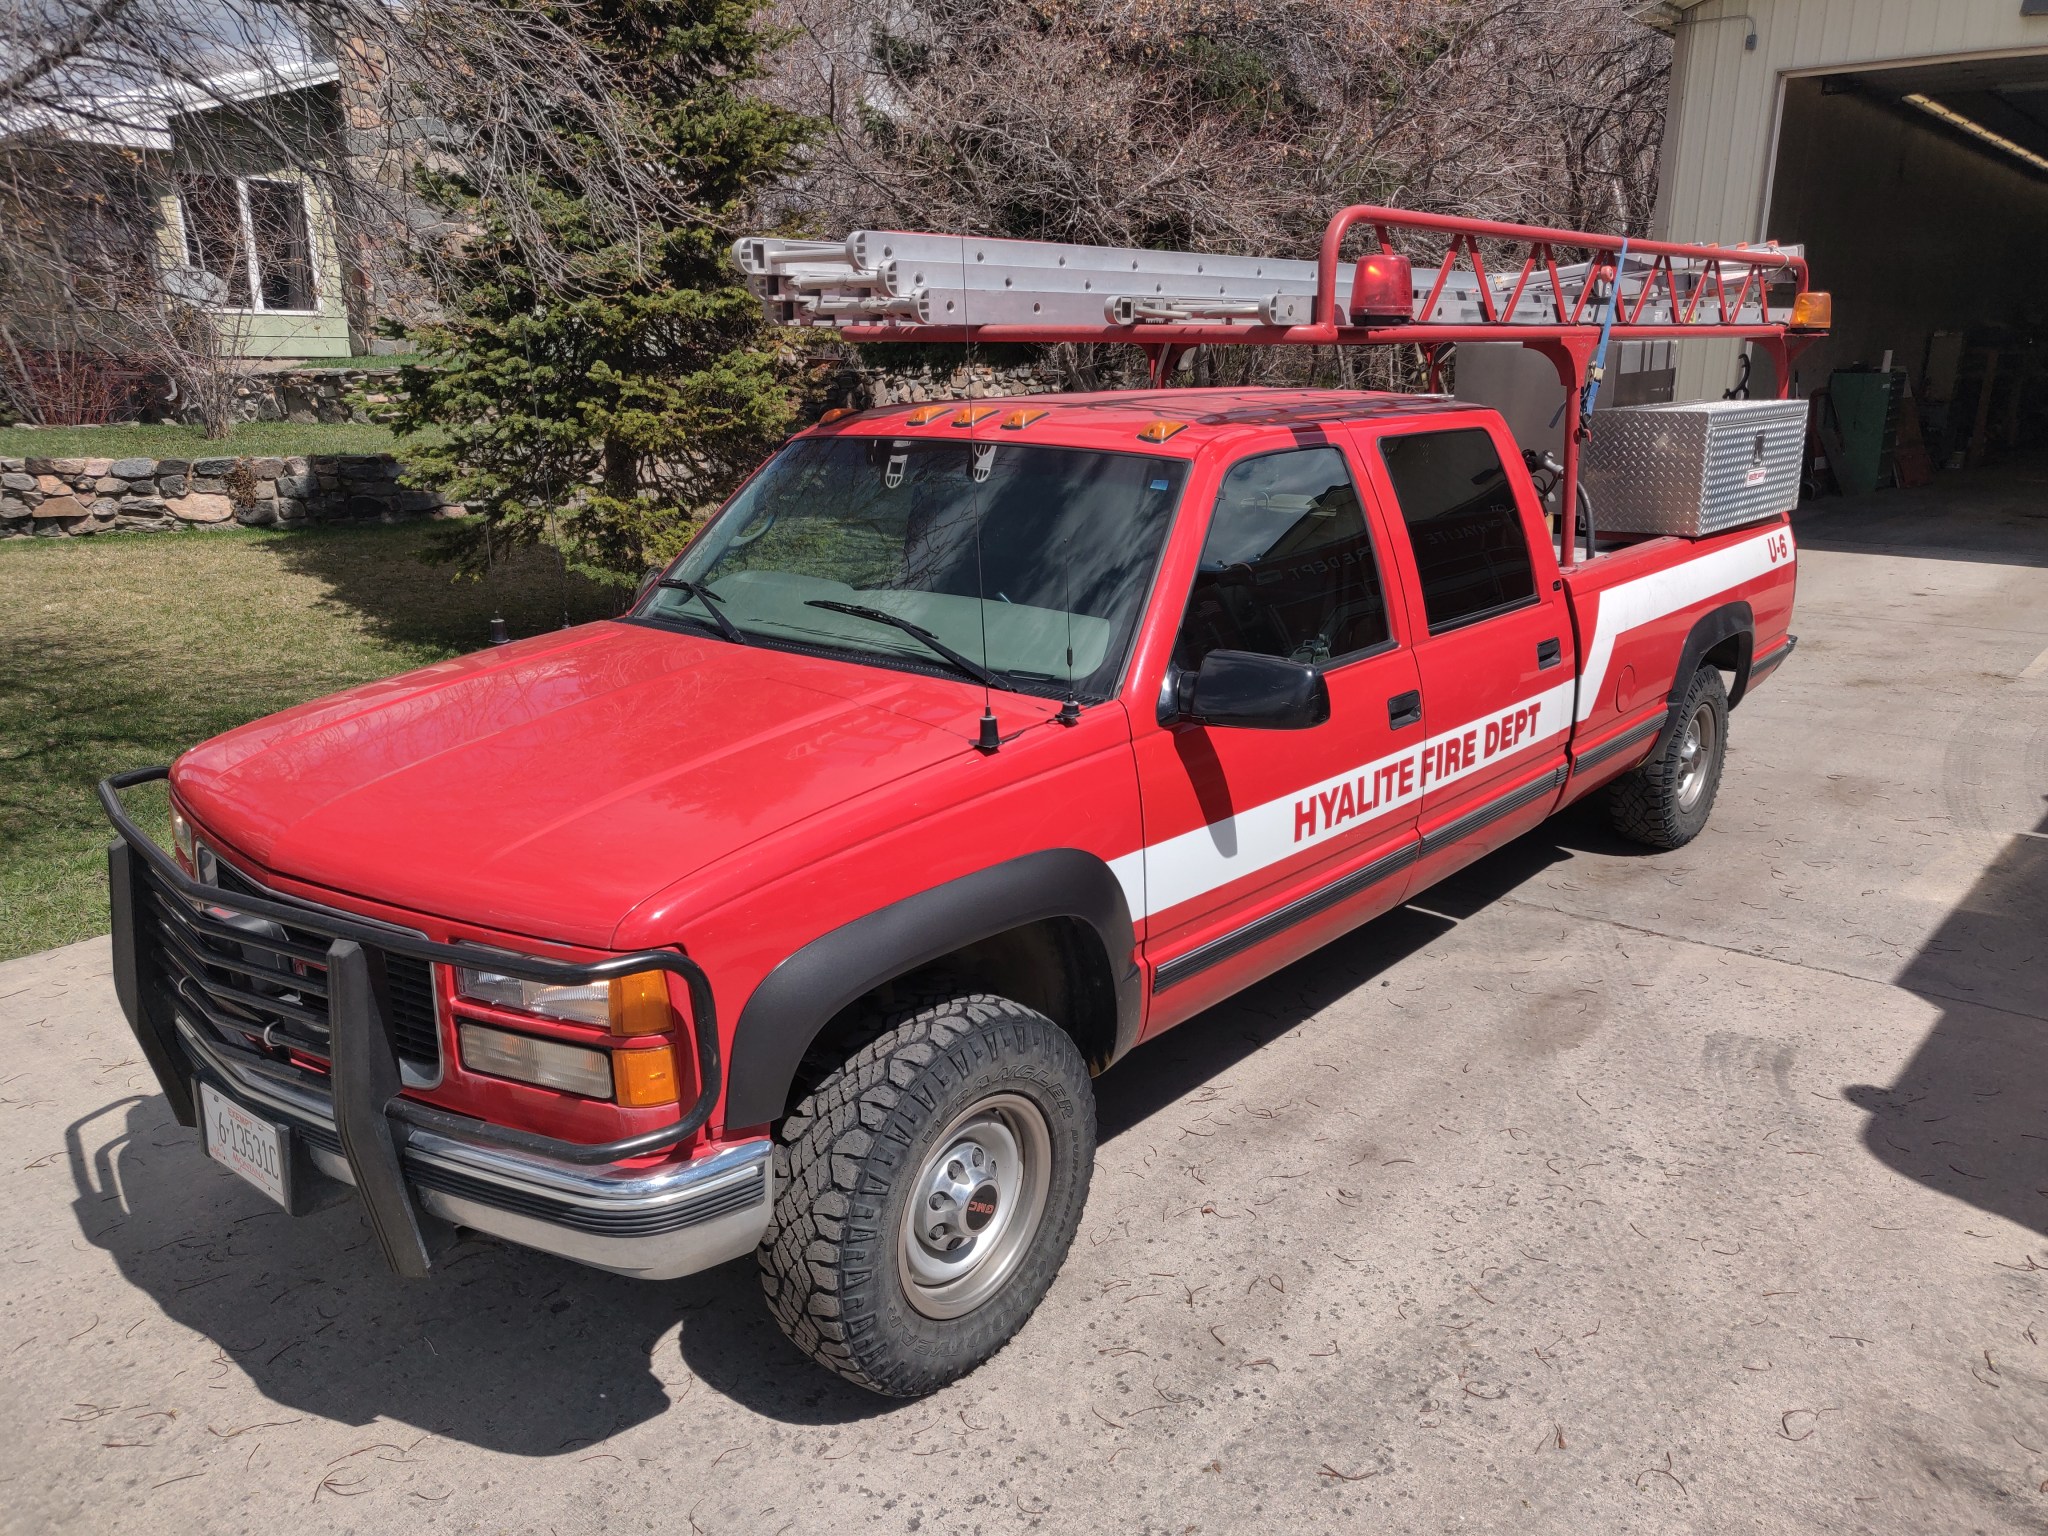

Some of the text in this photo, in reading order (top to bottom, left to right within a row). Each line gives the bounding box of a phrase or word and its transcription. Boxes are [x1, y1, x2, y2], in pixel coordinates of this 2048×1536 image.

[1767, 534, 1787, 563] U-6
[1294, 702, 1541, 843] HYALITE FIRE DEPT
[968, 1200, 995, 1215] GMC
